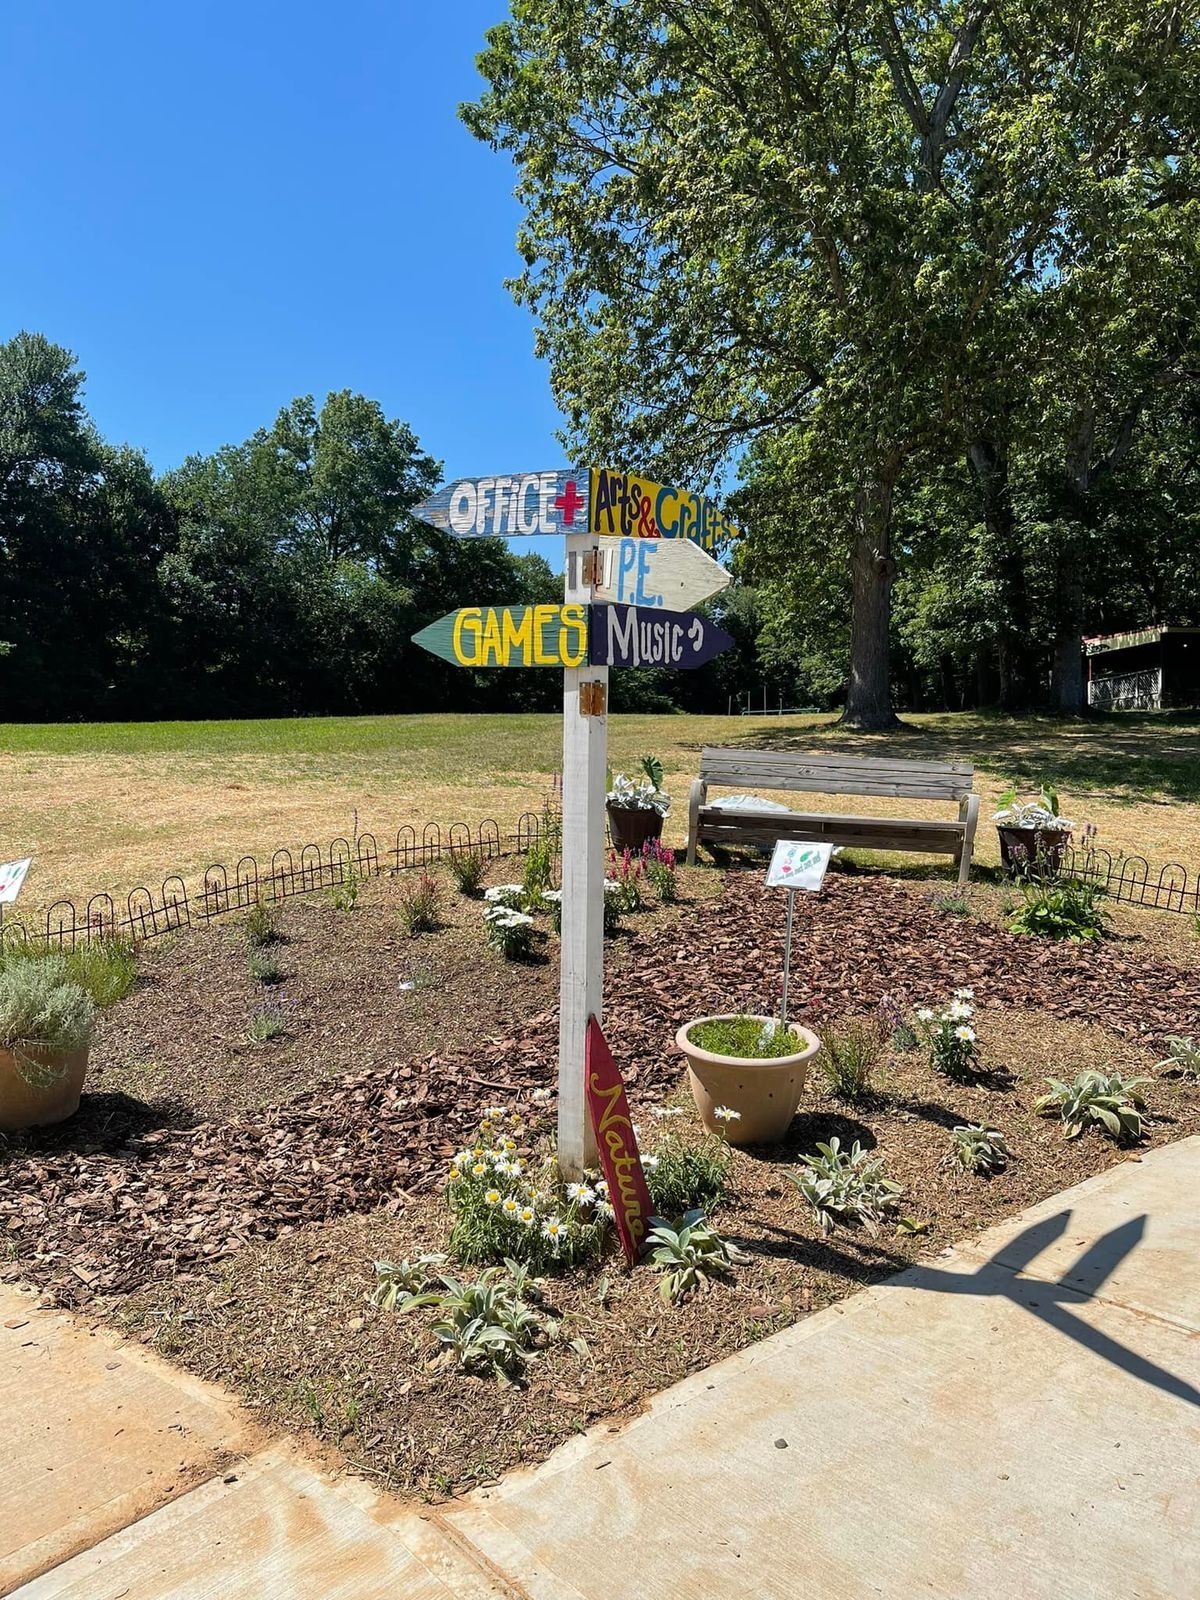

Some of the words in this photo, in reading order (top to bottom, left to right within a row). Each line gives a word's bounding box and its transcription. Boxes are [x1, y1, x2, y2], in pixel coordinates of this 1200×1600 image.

[617, 538, 663, 606] P.E.
[453, 604, 587, 667] GAMES
[606, 605, 684, 666] Music
[590, 1072, 644, 1248] Nature
